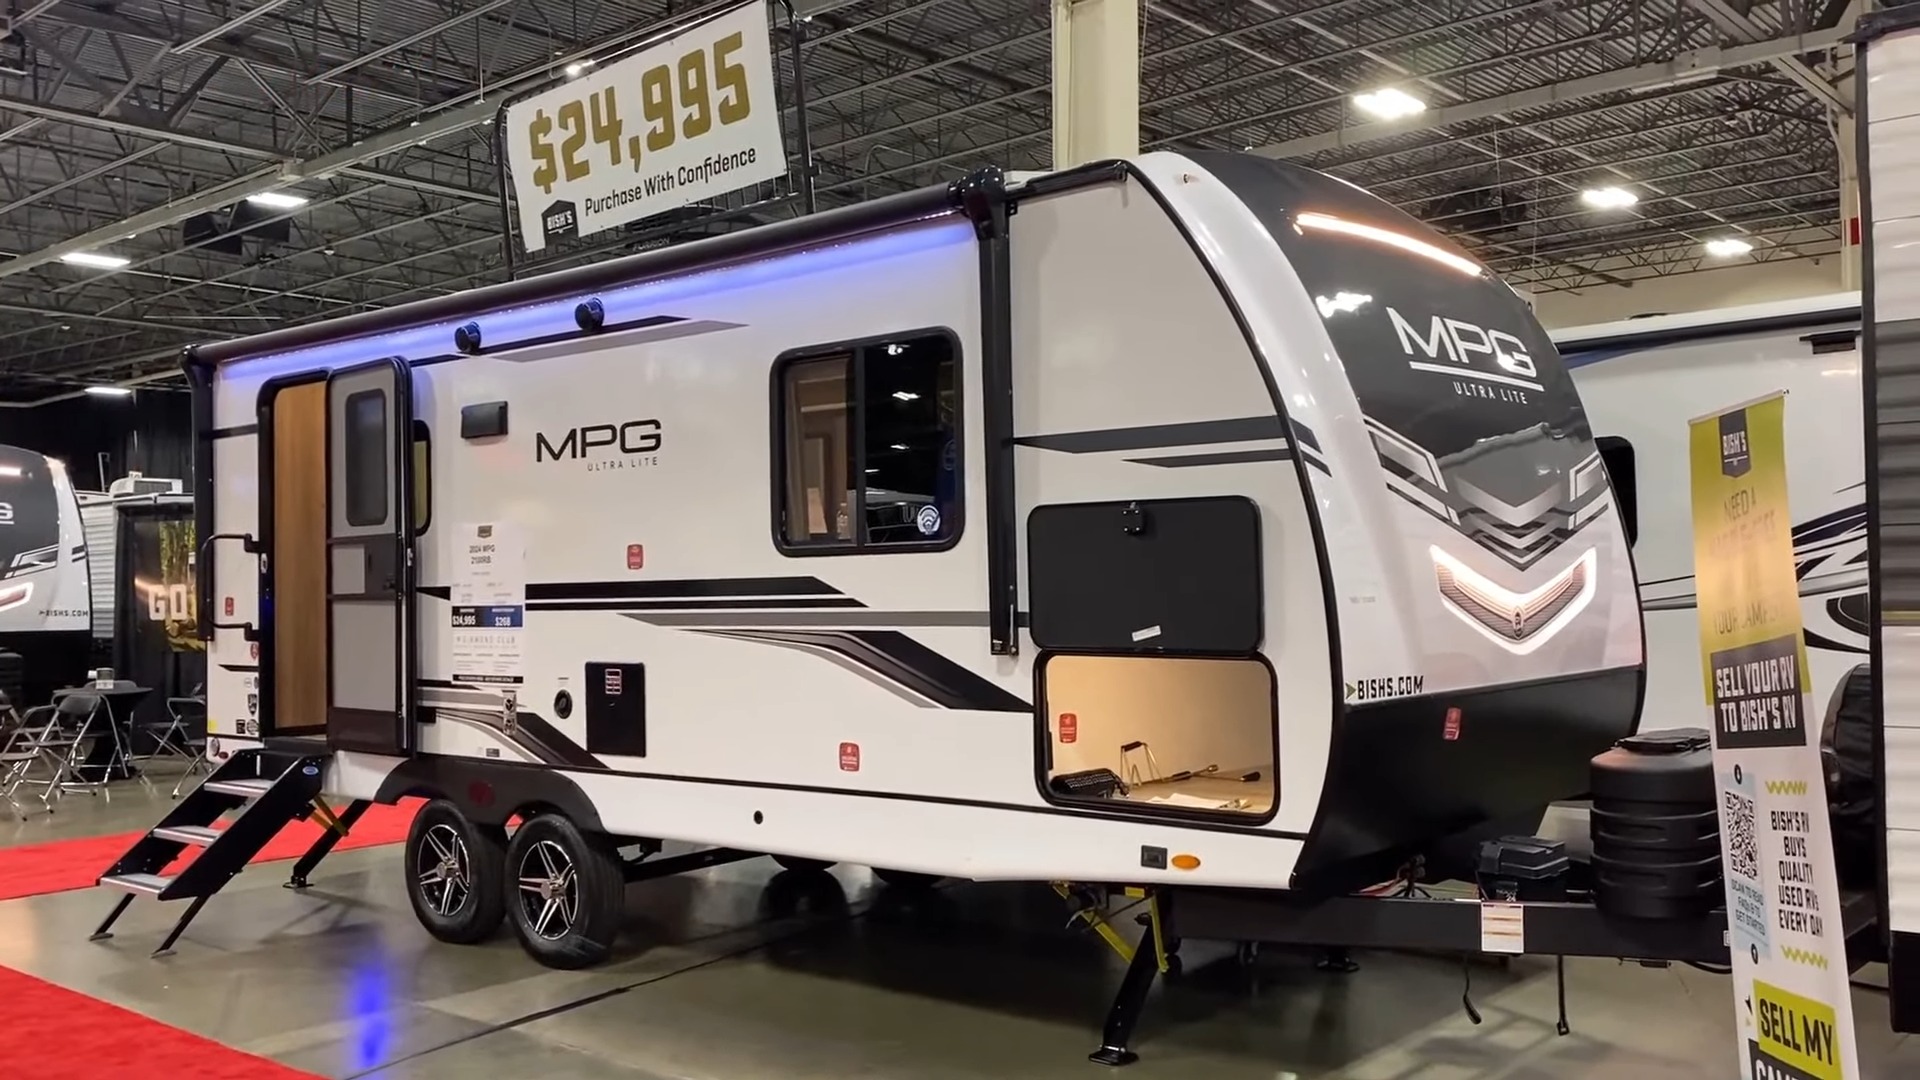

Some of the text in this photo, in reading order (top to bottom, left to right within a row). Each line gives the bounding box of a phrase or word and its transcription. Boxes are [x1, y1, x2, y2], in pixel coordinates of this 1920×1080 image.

[529, 30, 751, 195] $24,995
[585, 147, 757, 217] Purchase With Confidence
[547, 210, 573, 230] BISH'S
[1386, 306, 1537, 378] MPG
[1453, 381, 1528, 405] ULTRA LITE
[536, 419, 661, 463] MPG
[1722, 430, 1747, 456] BISH'S
[587, 456, 658, 471] ULTRA LITE
[149, 584, 188, 621] GO
[1357, 675, 1424, 700] BISHS.COM
[1716, 654, 1794, 698] SELL YOUR RV
[1720, 694, 1796, 732] TO BISH'S RV
[1771, 810, 1800, 832] BISH'S
[1783, 836, 1806, 858] BUYS
[1778, 860, 1814, 884] QUALITY
[1778, 884, 1803, 907] USED
[1778, 909, 1824, 937] EVERY DAY
[1759, 998, 1832, 1066] SELL MY
